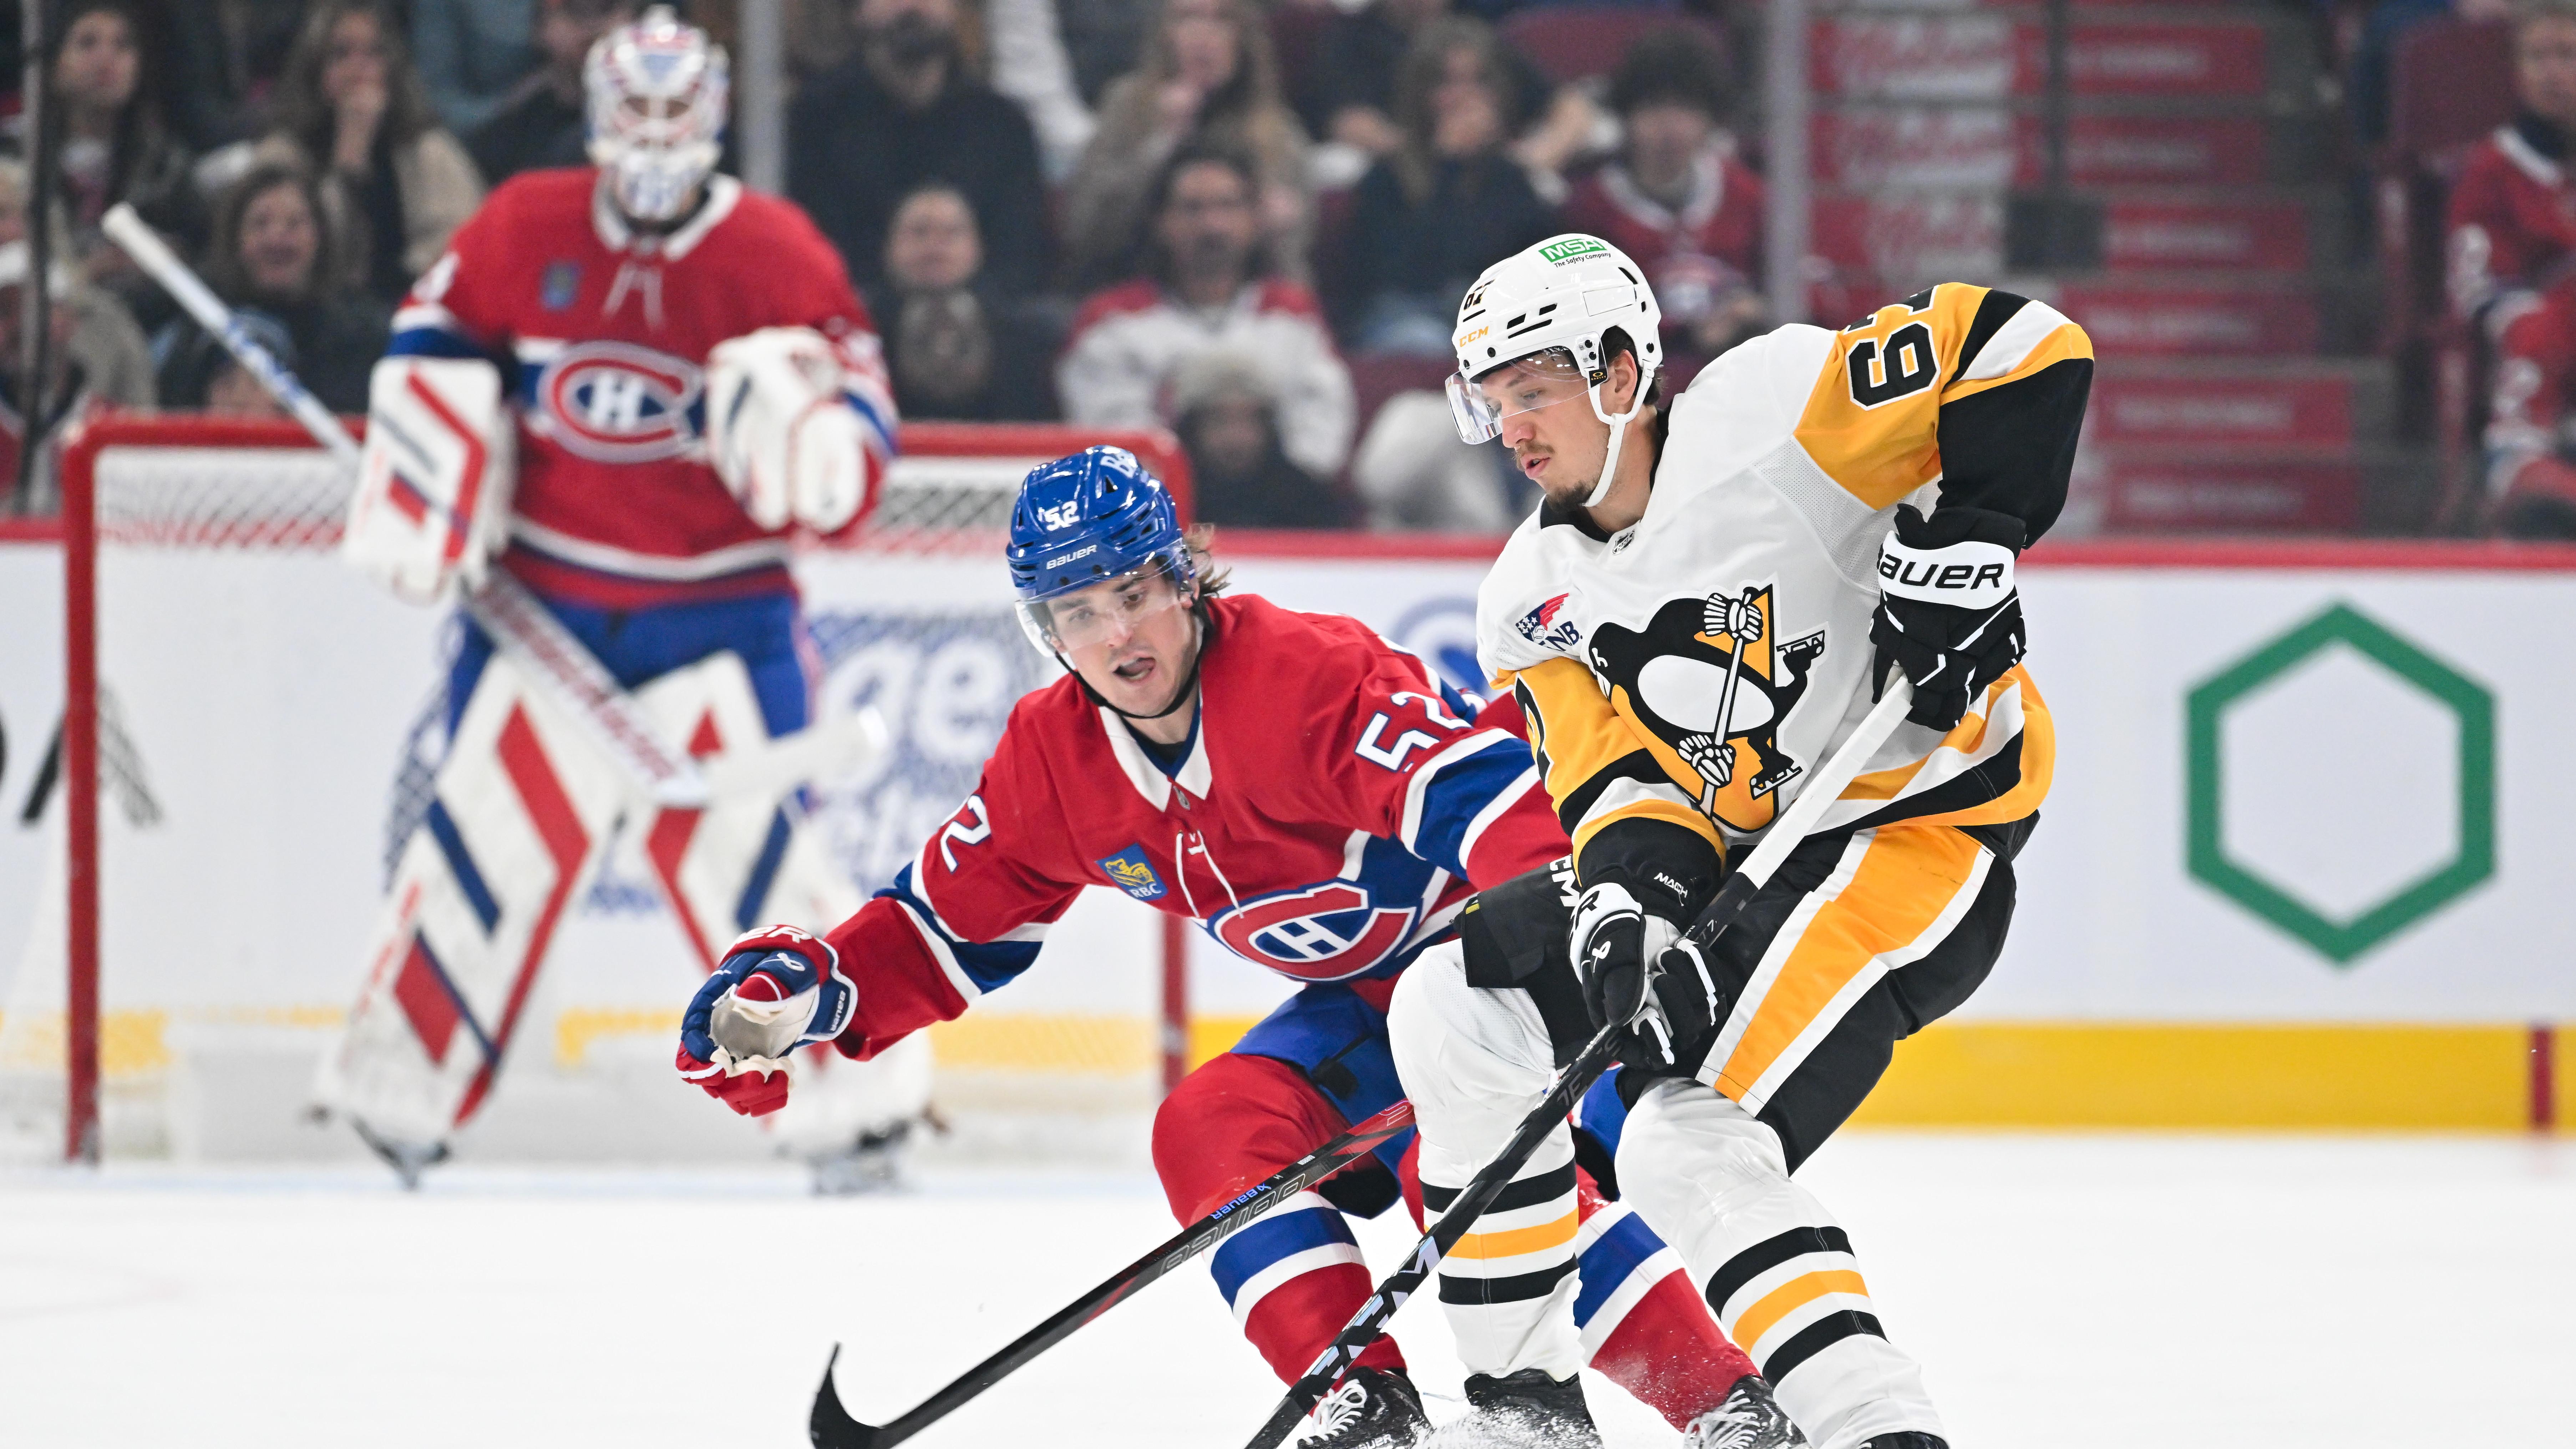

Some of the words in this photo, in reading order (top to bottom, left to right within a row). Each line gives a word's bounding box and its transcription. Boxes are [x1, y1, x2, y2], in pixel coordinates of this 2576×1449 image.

[1543, 238, 1603, 260] MSA
[1459, 325, 1489, 348] CCM
[1044, 500, 1080, 531] 52
[1046, 544, 1098, 570] BAUER
[1356, 691, 1474, 773] 52
[939, 793, 992, 874] 2
[1129, 883, 1162, 898] RBC
[1550, 853, 1581, 907] CM
[1653, 872, 1688, 898] MACH
[1210, 1189, 1258, 1220] BAUER
